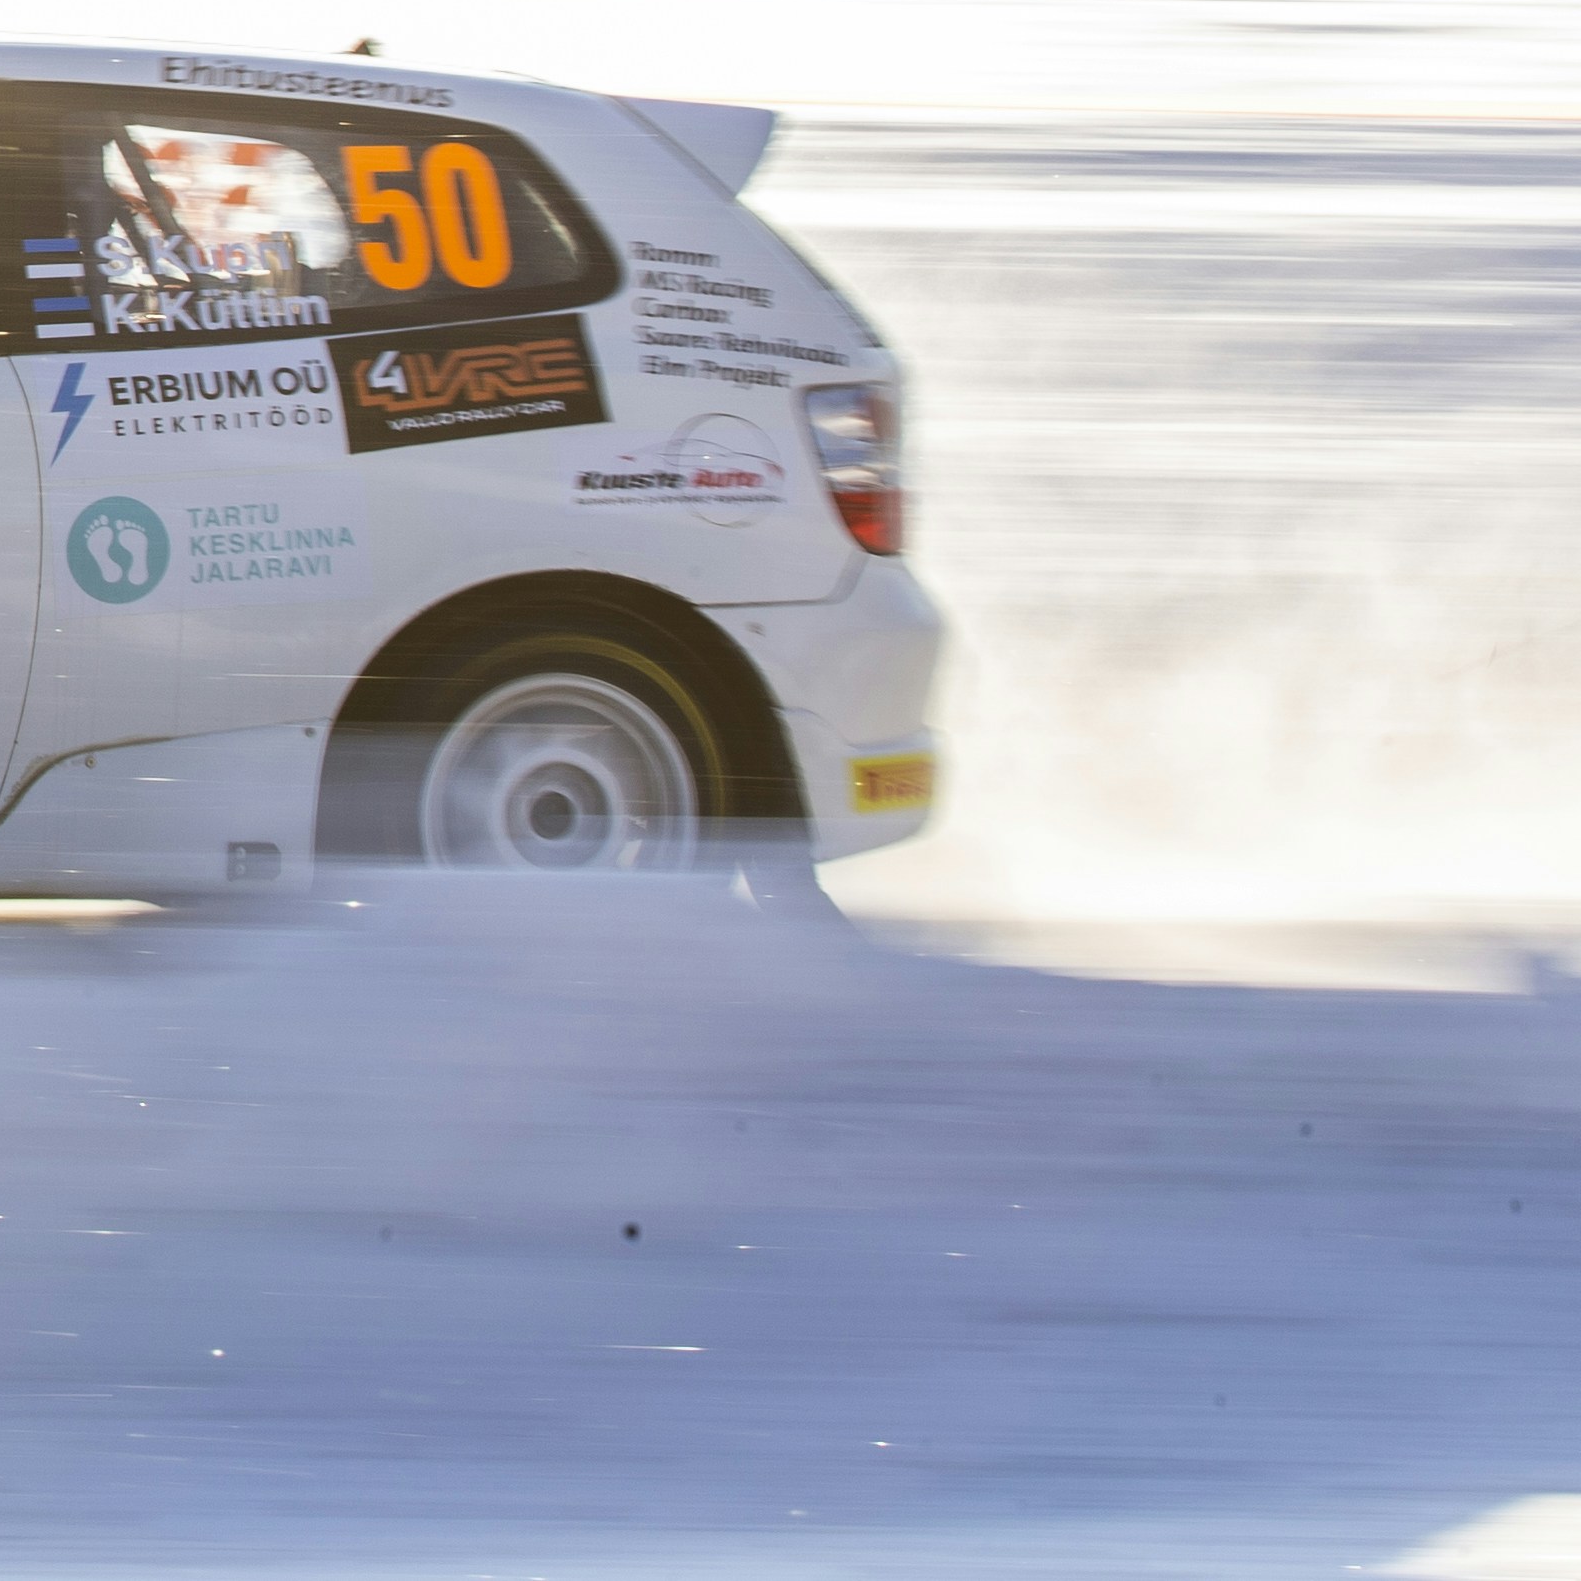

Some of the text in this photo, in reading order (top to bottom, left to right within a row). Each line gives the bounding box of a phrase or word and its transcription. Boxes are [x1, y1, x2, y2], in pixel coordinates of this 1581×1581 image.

[160, 56, 456, 109] Ehitusteenus
[341, 142, 513, 291] 50
[100, 288, 332, 334] K.Küttim
[108, 359, 328, 405] ERBIUM OÜ
[114, 404, 333, 436] ELEKTRITÖÖD
[453, 404, 517, 424] RALLY
[518, 399, 566, 417] CAR
[187, 503, 280, 530] TARTU
[189, 526, 356, 557] KESKLINNA
[190, 555, 332, 584] JALARAVI
